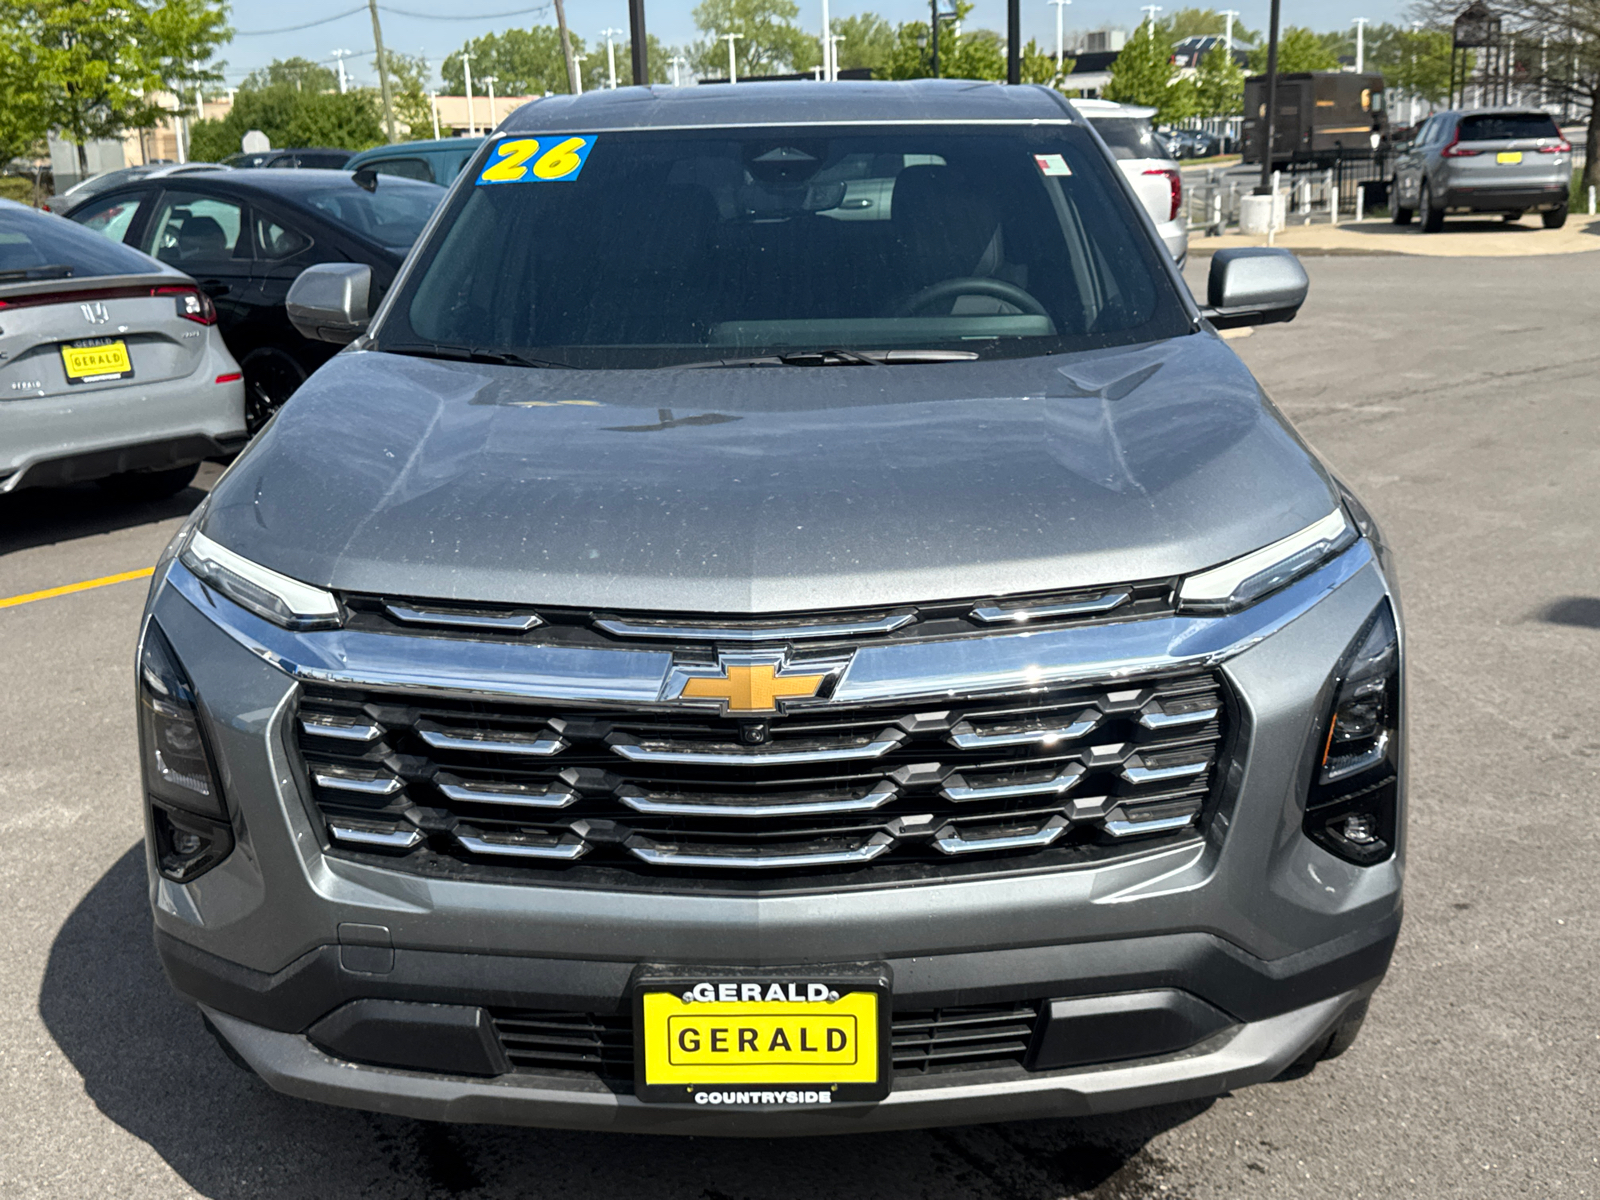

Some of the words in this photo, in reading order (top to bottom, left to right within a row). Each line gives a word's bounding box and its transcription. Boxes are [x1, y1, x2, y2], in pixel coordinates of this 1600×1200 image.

[481, 137, 587, 182] 26
[74, 353, 120, 366] GERALD
[692, 983, 829, 1002] GERALD
[678, 1027, 848, 1052] GERALD
[694, 1091, 832, 1105] COUNTRYSIDE
